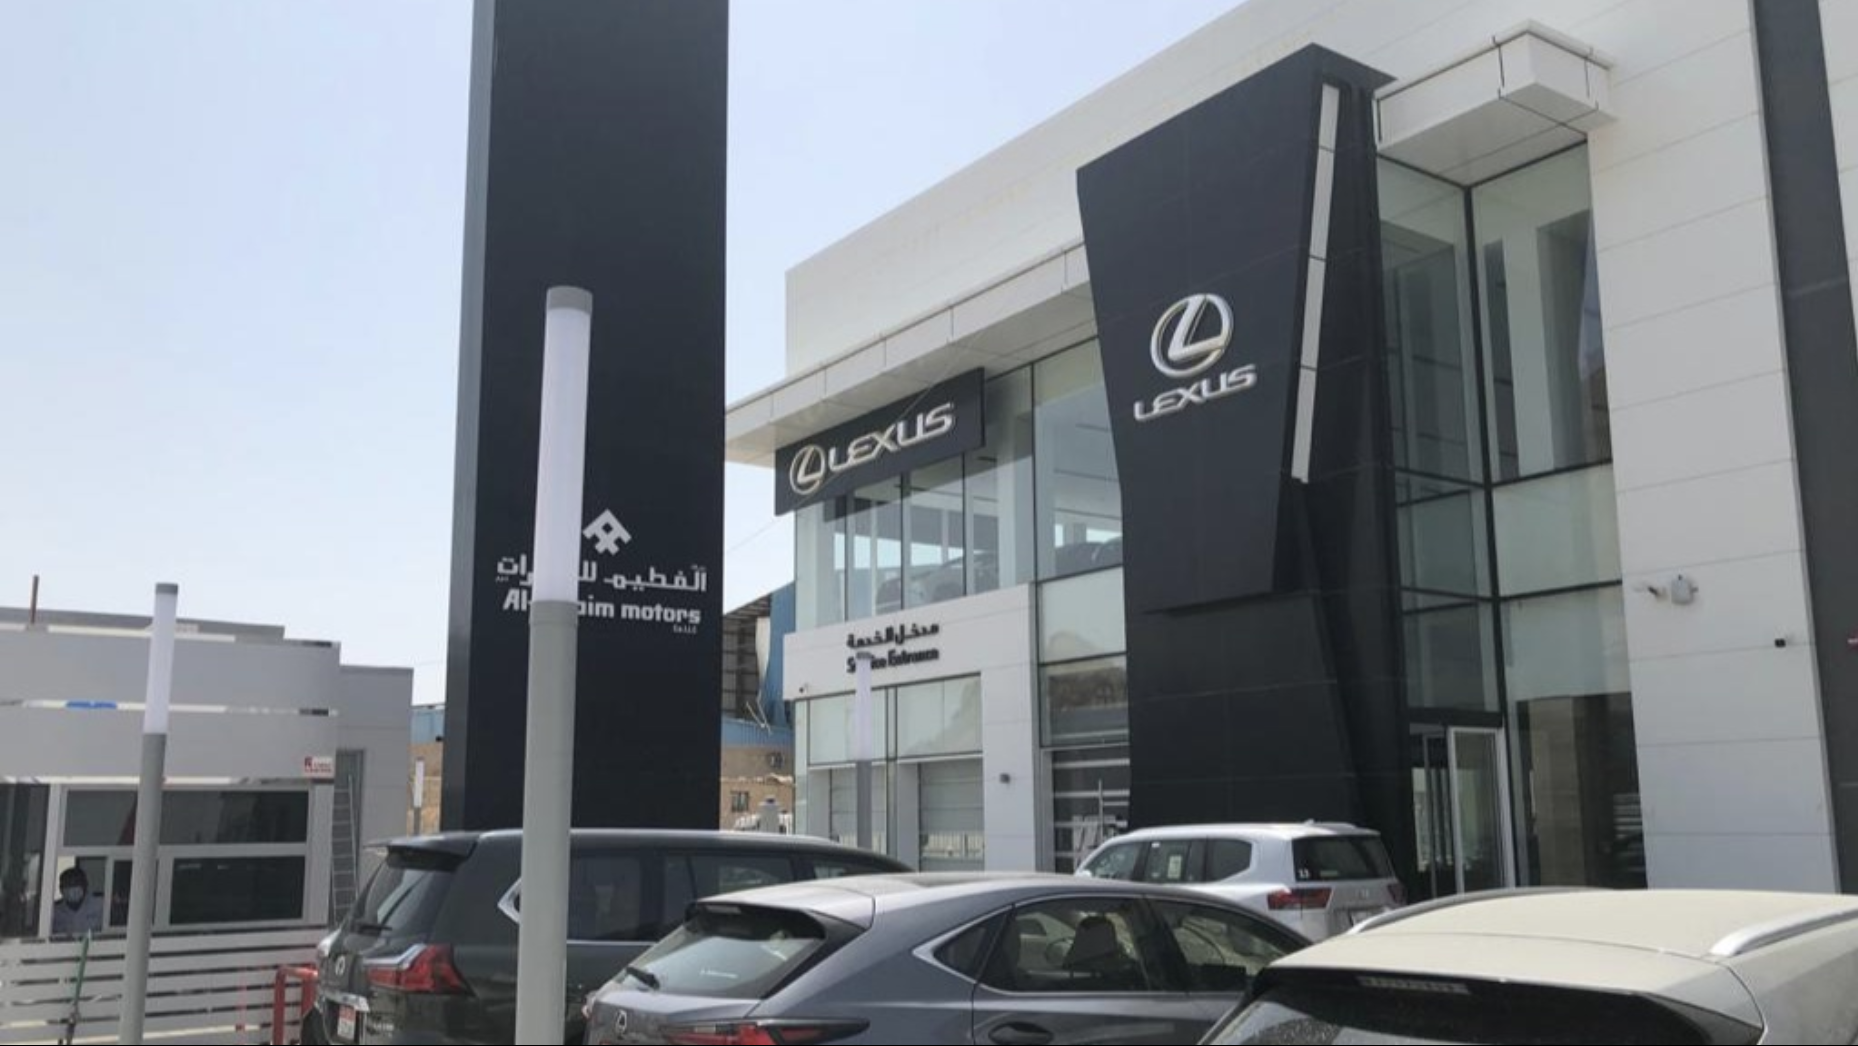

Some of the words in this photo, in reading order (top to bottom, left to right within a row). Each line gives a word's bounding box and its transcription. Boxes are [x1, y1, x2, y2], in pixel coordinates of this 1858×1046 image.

[1133, 363, 1258, 421] LEXUS
[828, 402, 955, 472] LEXUS
[620, 602, 702, 625] motors
[846, 626, 894, 649] الخدمة
[895, 623, 940, 645] مدخل
[846, 654, 887, 674] Sice
